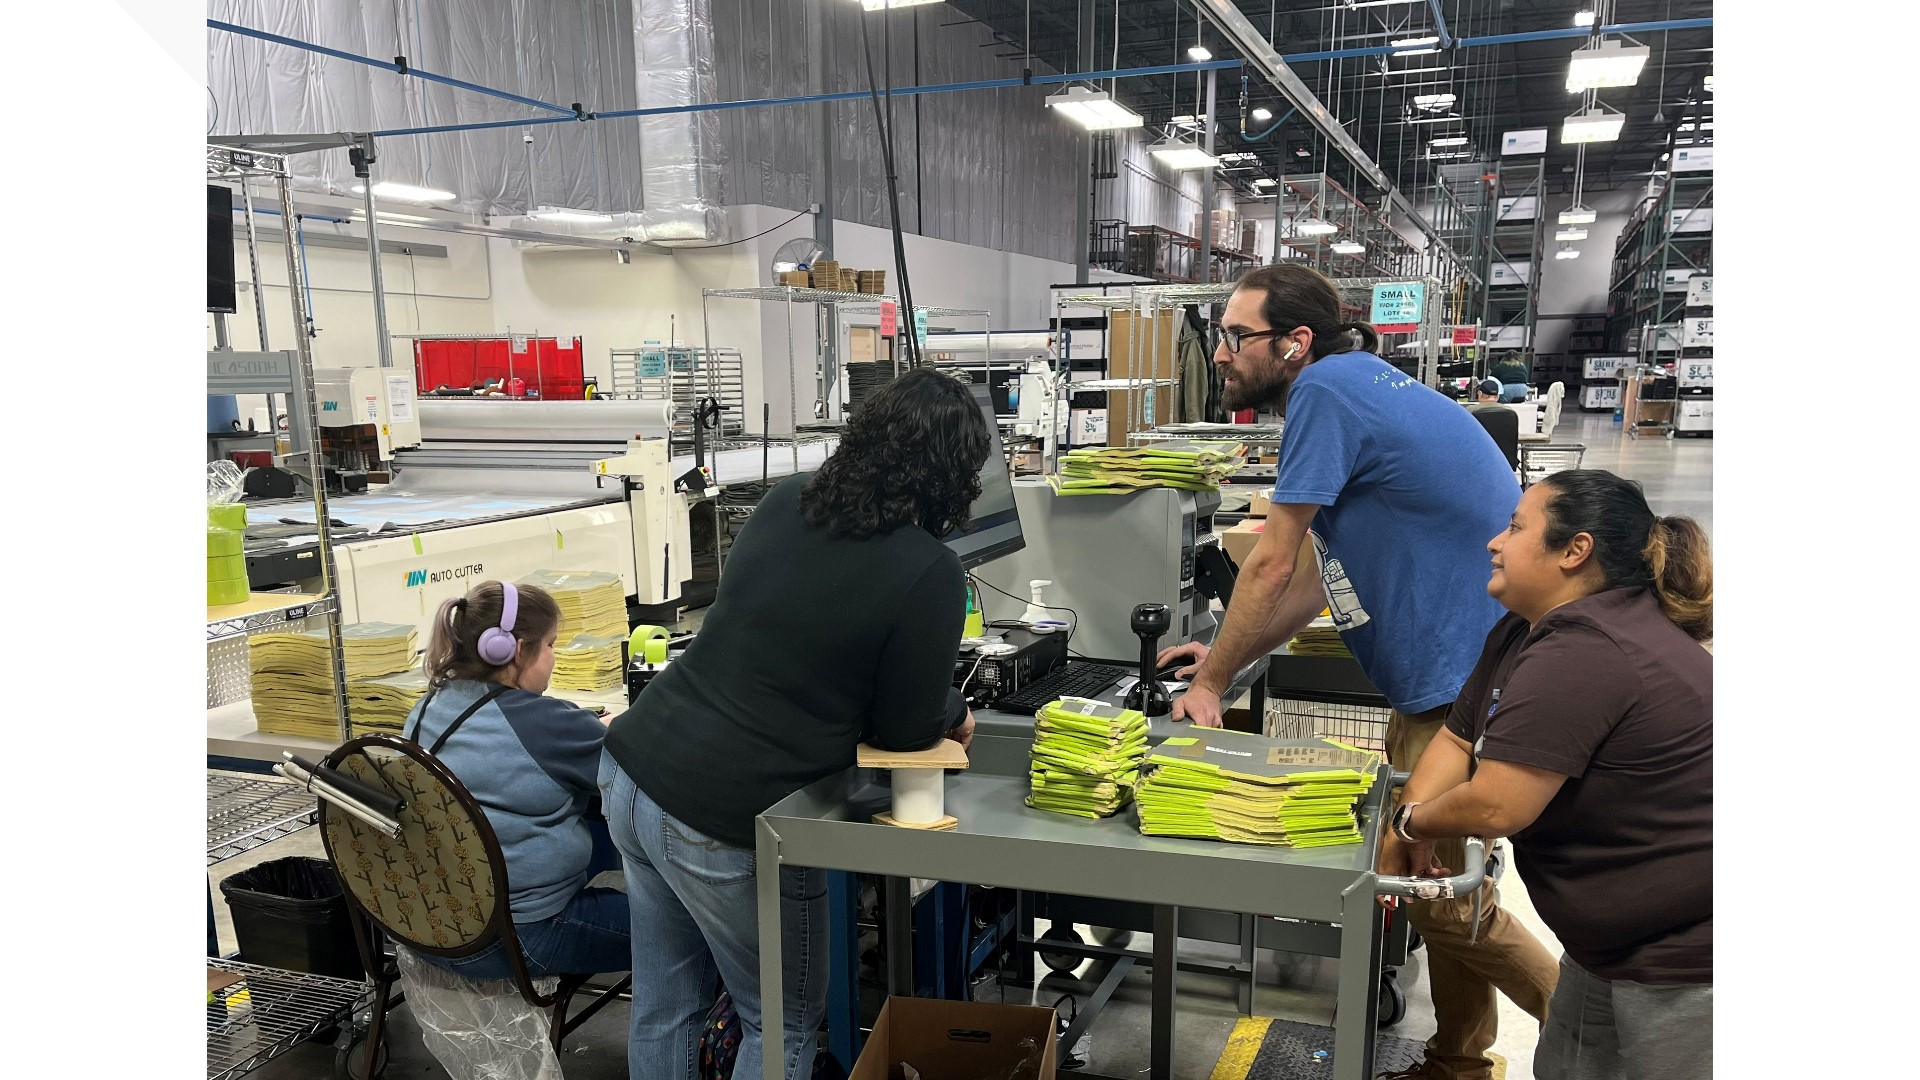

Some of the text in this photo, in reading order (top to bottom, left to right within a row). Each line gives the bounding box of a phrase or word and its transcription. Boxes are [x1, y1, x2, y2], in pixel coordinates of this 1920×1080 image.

[233, 152, 251, 163] ULINE
[1380, 290, 1416, 299] SMALL
[430, 569, 453, 584] AUTO
[454, 563, 484, 579] CUTTER
